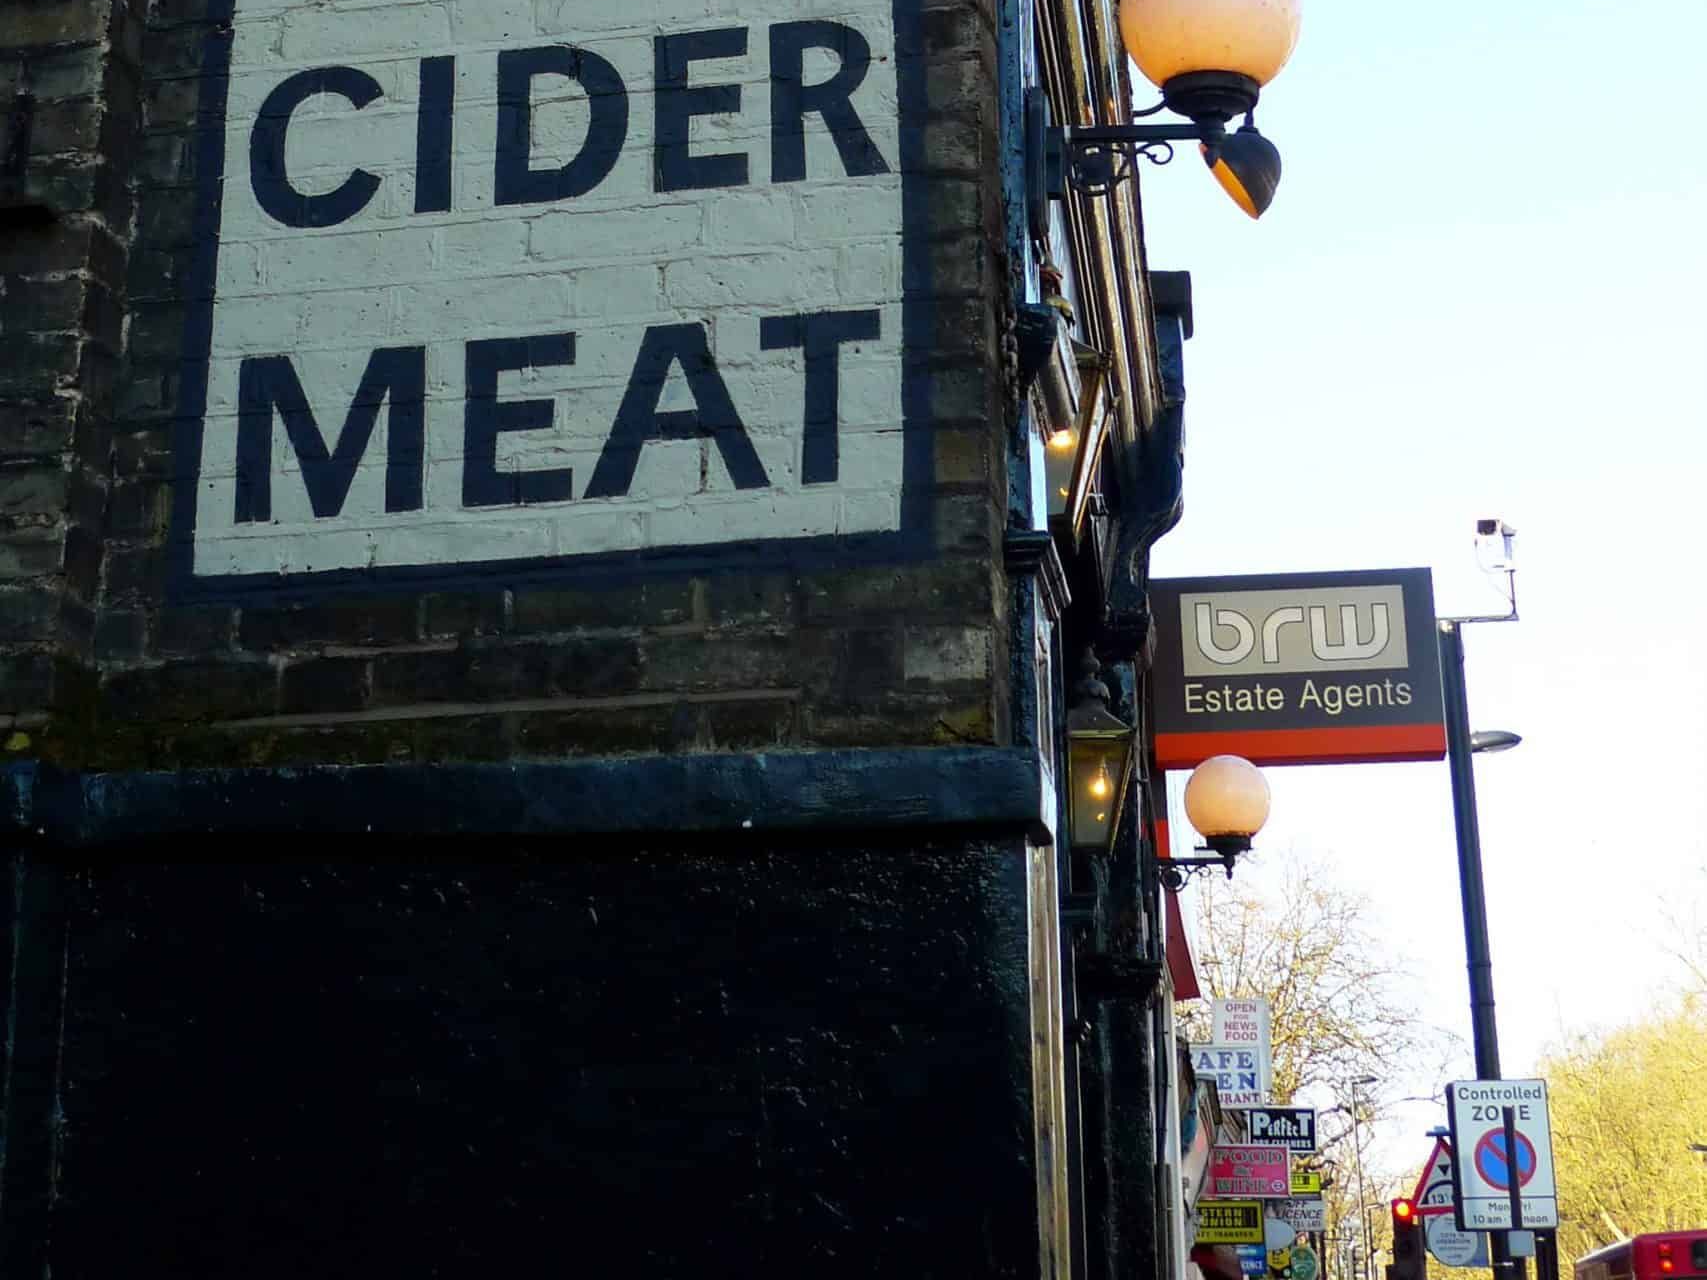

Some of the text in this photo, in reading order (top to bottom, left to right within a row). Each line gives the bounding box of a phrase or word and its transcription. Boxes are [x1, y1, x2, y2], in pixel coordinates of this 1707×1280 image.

[248, 20, 891, 228] CIDER
[233, 309, 882, 524] MEAT
[1194, 601, 1390, 665] brw
[1184, 679, 1412, 714] Estate Agents
[1225, 1003, 1257, 1013] OPEN
[1224, 1021, 1258, 1030] NEWS
[1225, 1031, 1258, 1040] FOOD
[1196, 1051, 1253, 1069] AFE
[1216, 1072, 1256, 1090] EN
[1458, 1086, 1542, 1100] Controlled
[1472, 1105, 1531, 1121] ZOE
[1215, 1148, 1284, 1165] FOOD
[1216, 1177, 1270, 1193] WINE
[1473, 1214, 1485, 1224] 10
